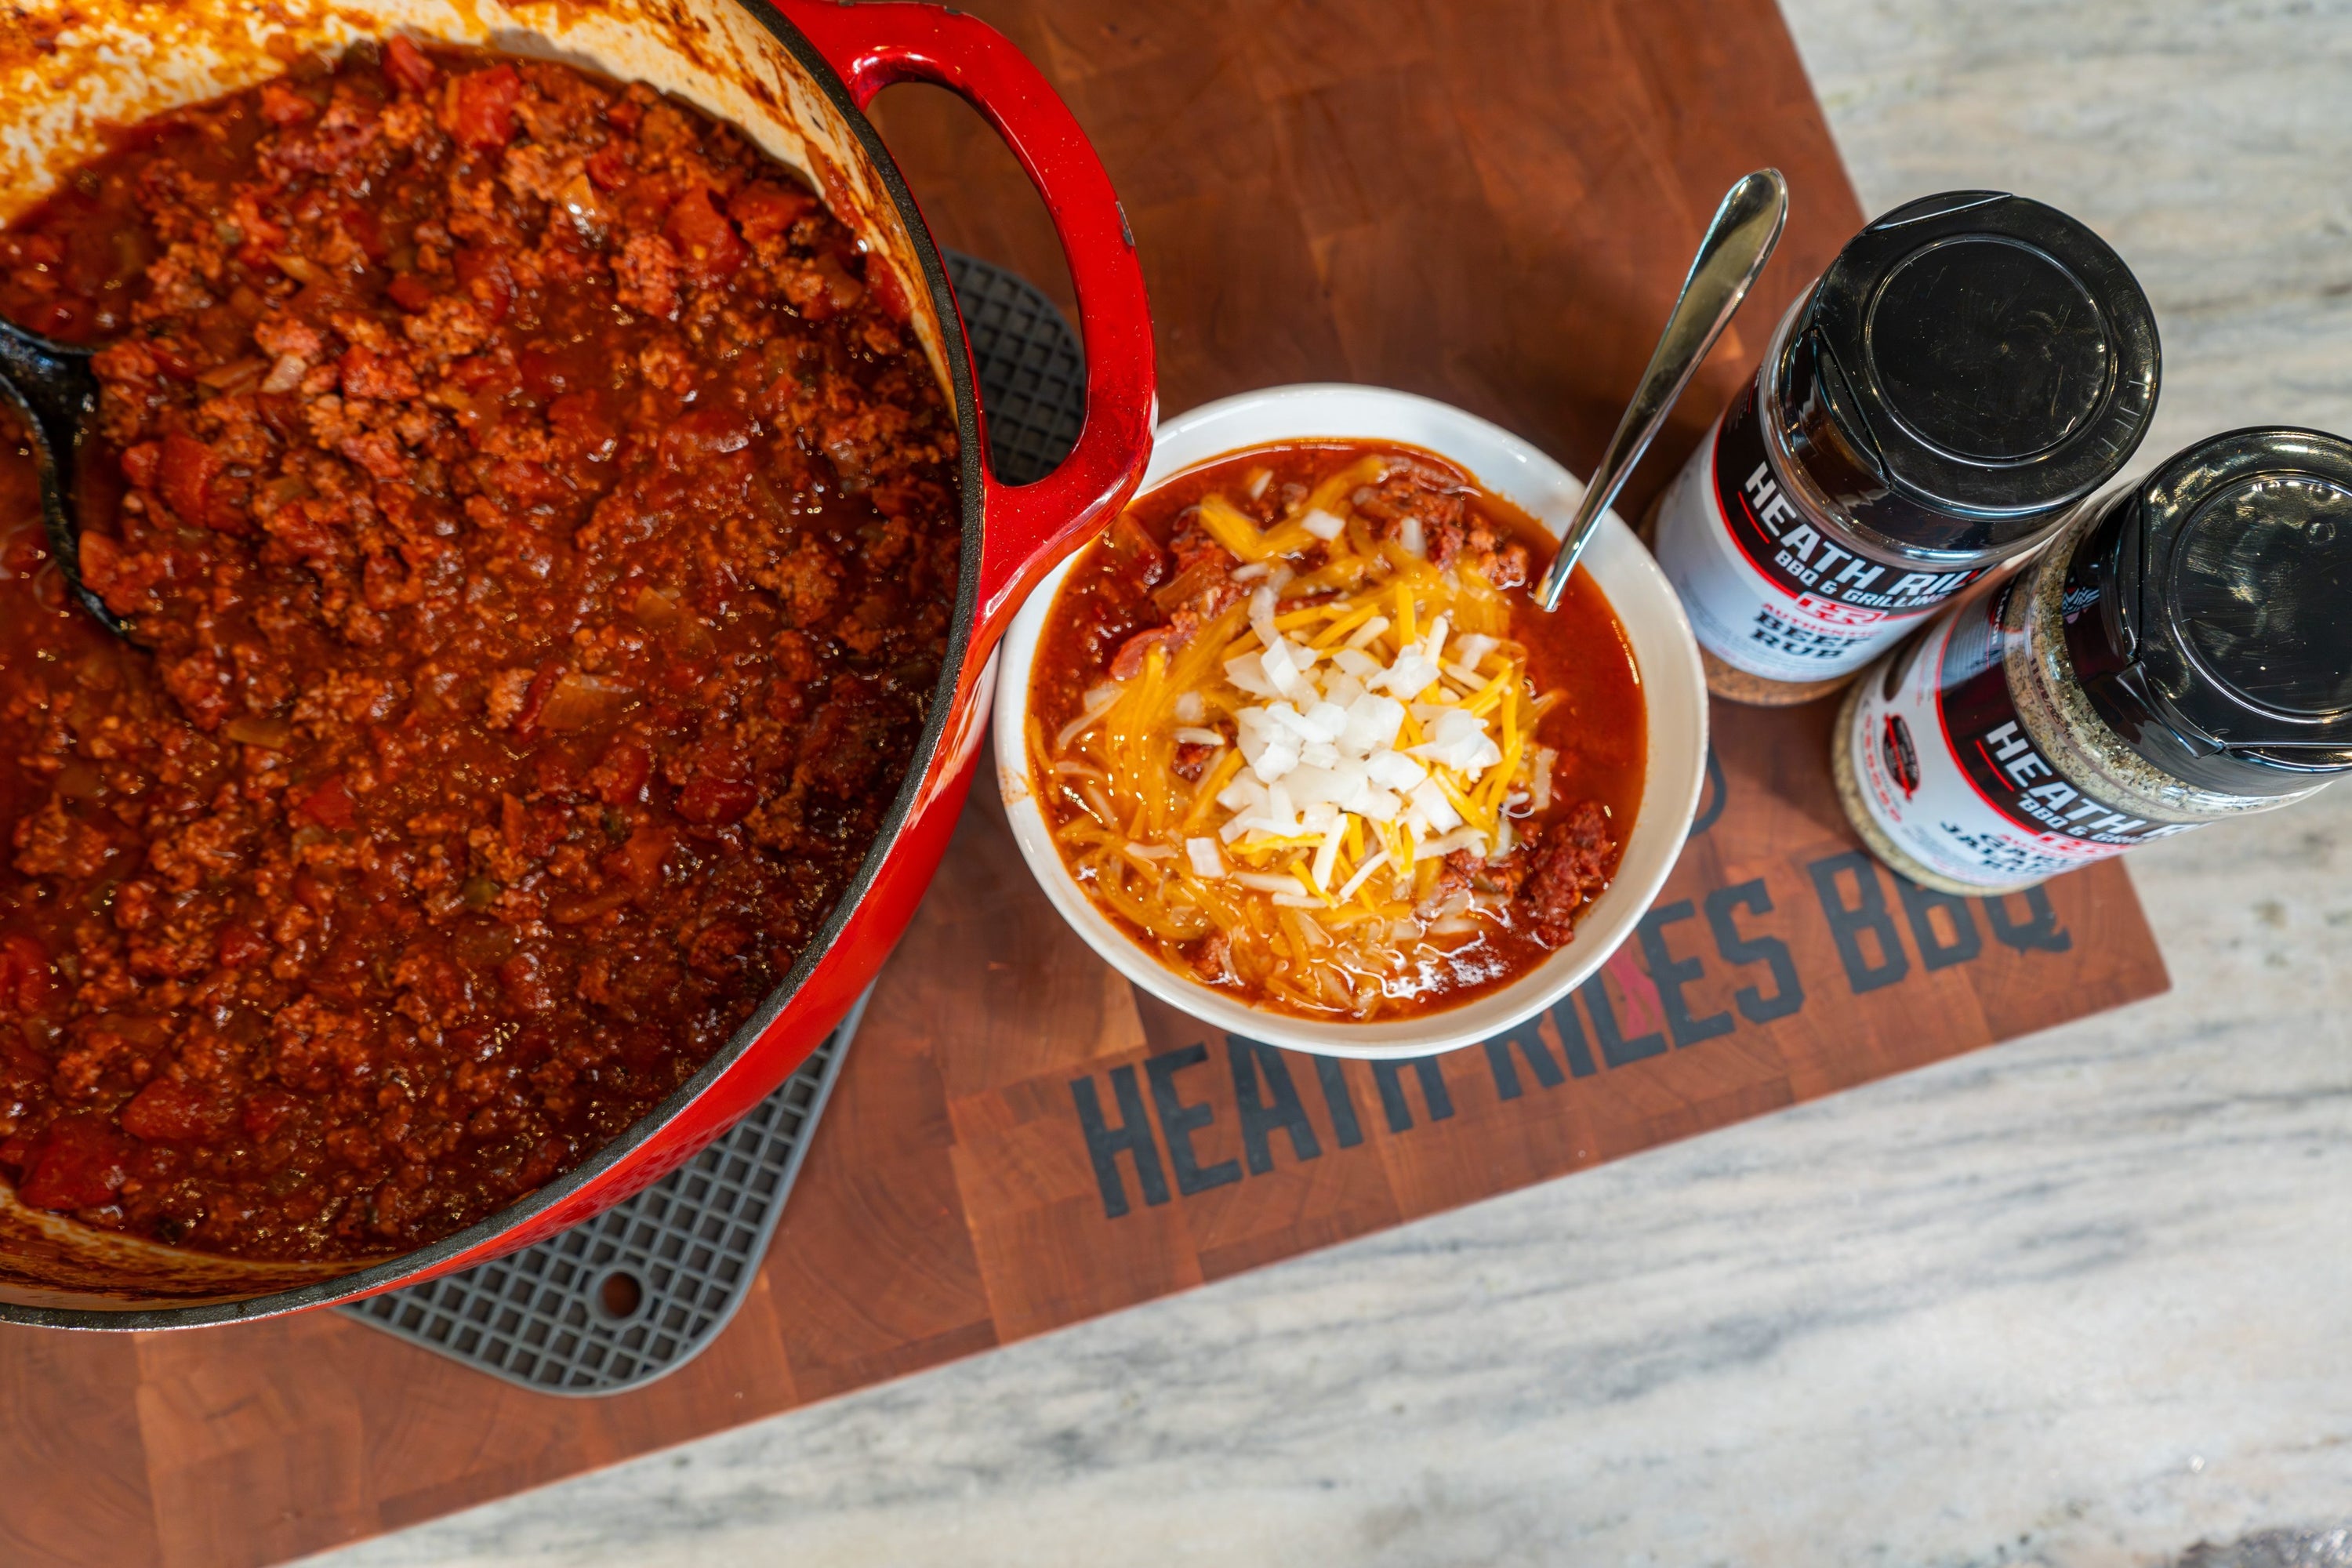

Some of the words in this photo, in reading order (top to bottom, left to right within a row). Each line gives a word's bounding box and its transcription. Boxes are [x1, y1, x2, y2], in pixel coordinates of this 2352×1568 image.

[1744, 460, 1886, 590] HEATH
[1773, 549, 1820, 588] BBQ
[1819, 579, 1838, 596] &
[1750, 628, 1845, 660] RUB
[1755, 610, 1872, 648] BEEF
[1985, 720, 2147, 834] HEATH
[2017, 797, 2069, 829] BBQ
[2067, 825, 2089, 837] &
